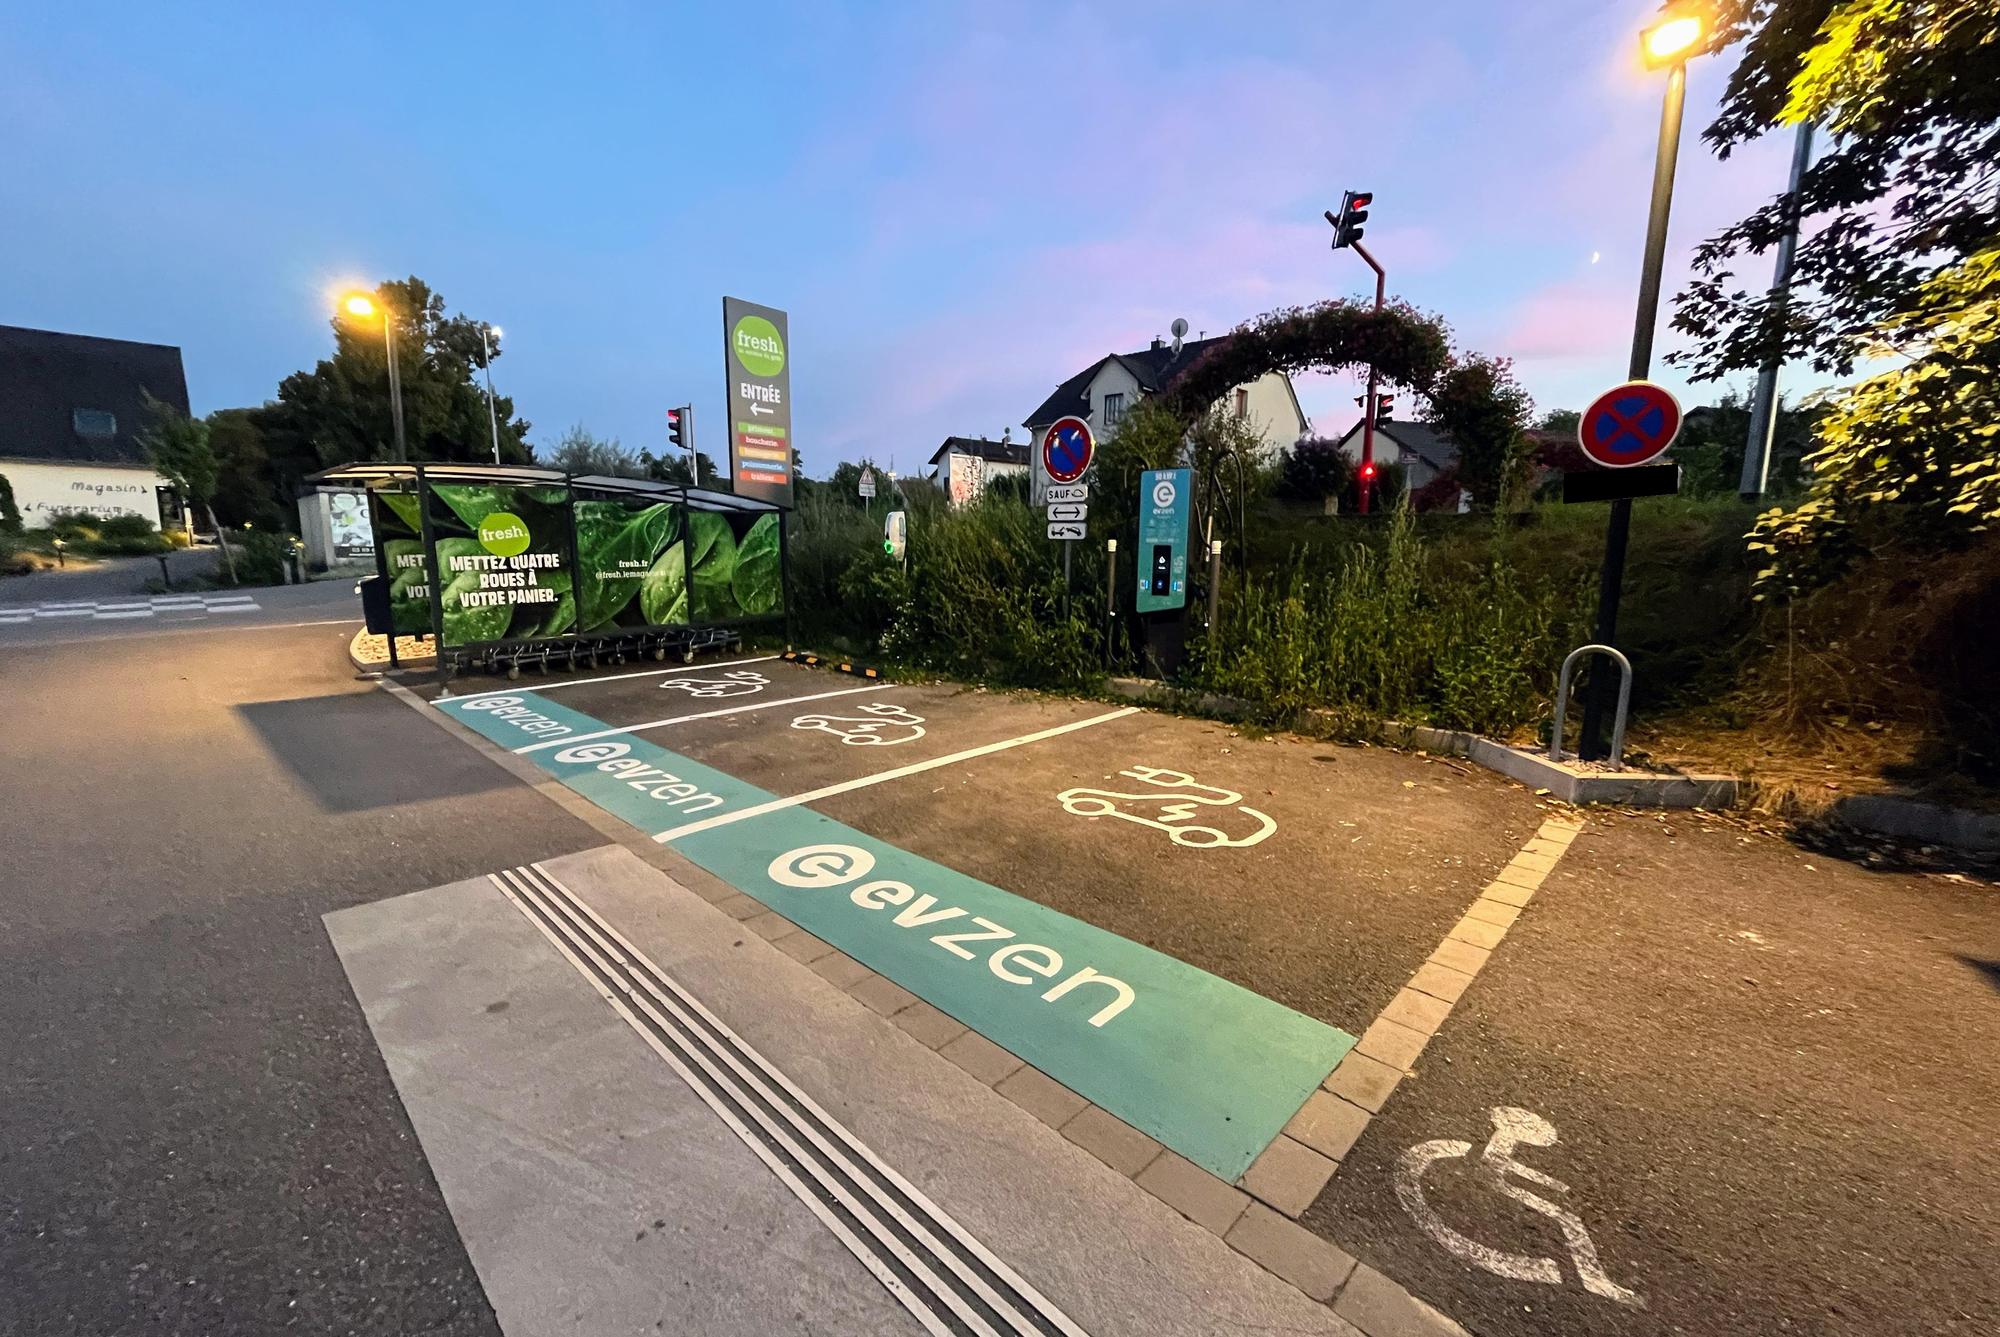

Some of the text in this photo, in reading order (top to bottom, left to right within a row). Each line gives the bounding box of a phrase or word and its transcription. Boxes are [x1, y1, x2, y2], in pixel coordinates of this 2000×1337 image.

[737, 329, 783, 355] fresh.
[740, 382, 781, 404] ENTRÉE
[71, 482, 137, 496] Magasin
[1048, 489, 1071, 500] SAUF
[481, 526, 528, 542] fresh.
[450, 554, 560, 571] METTEZ QUATRE
[479, 569, 538, 588] ROUES À
[459, 588, 559, 607] VOTRE PANIER.
[490, 705, 572, 738] evzen
[596, 759, 724, 813] evzen
[850, 880, 1136, 1028] evzen
